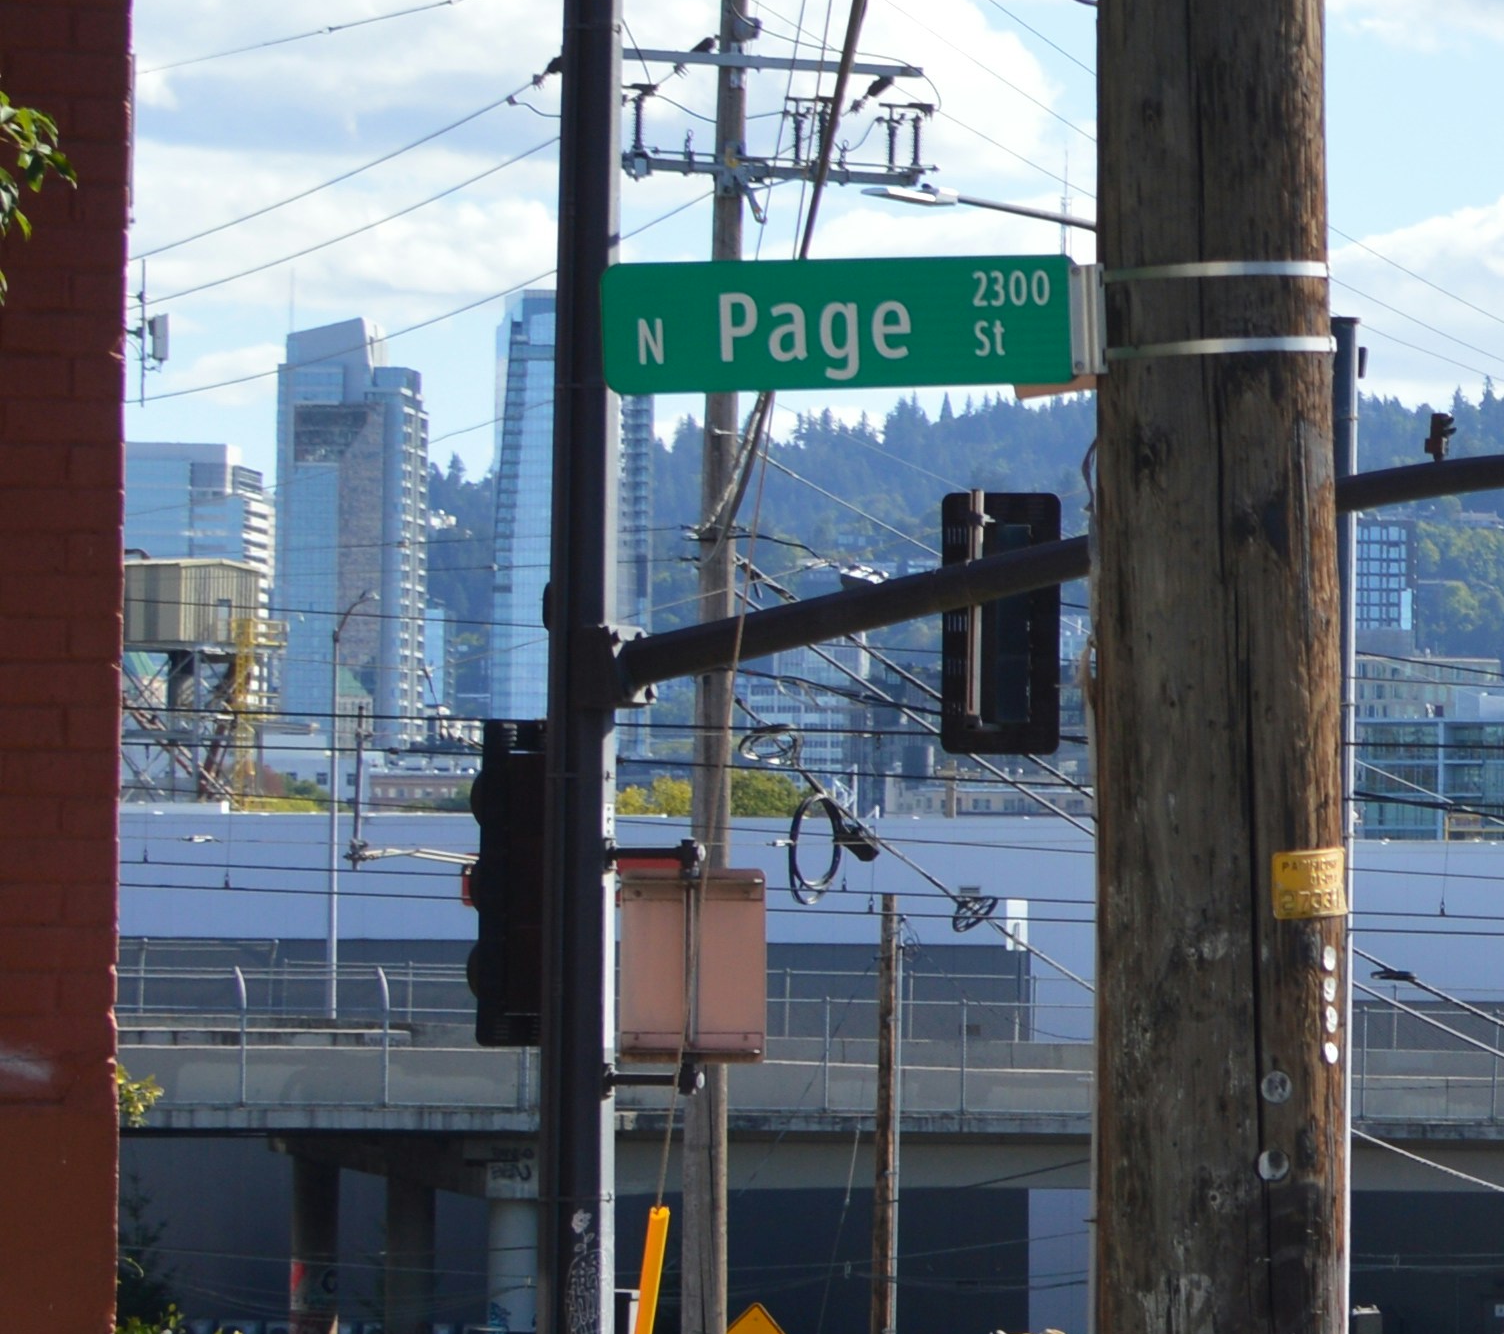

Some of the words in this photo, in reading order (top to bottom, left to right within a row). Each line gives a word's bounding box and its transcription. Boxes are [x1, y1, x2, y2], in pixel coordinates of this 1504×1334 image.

[972, 270, 1050, 307] 2300
[637, 317, 665, 365] N
[718, 292, 912, 381] Page
[974, 319, 1006, 357] St
